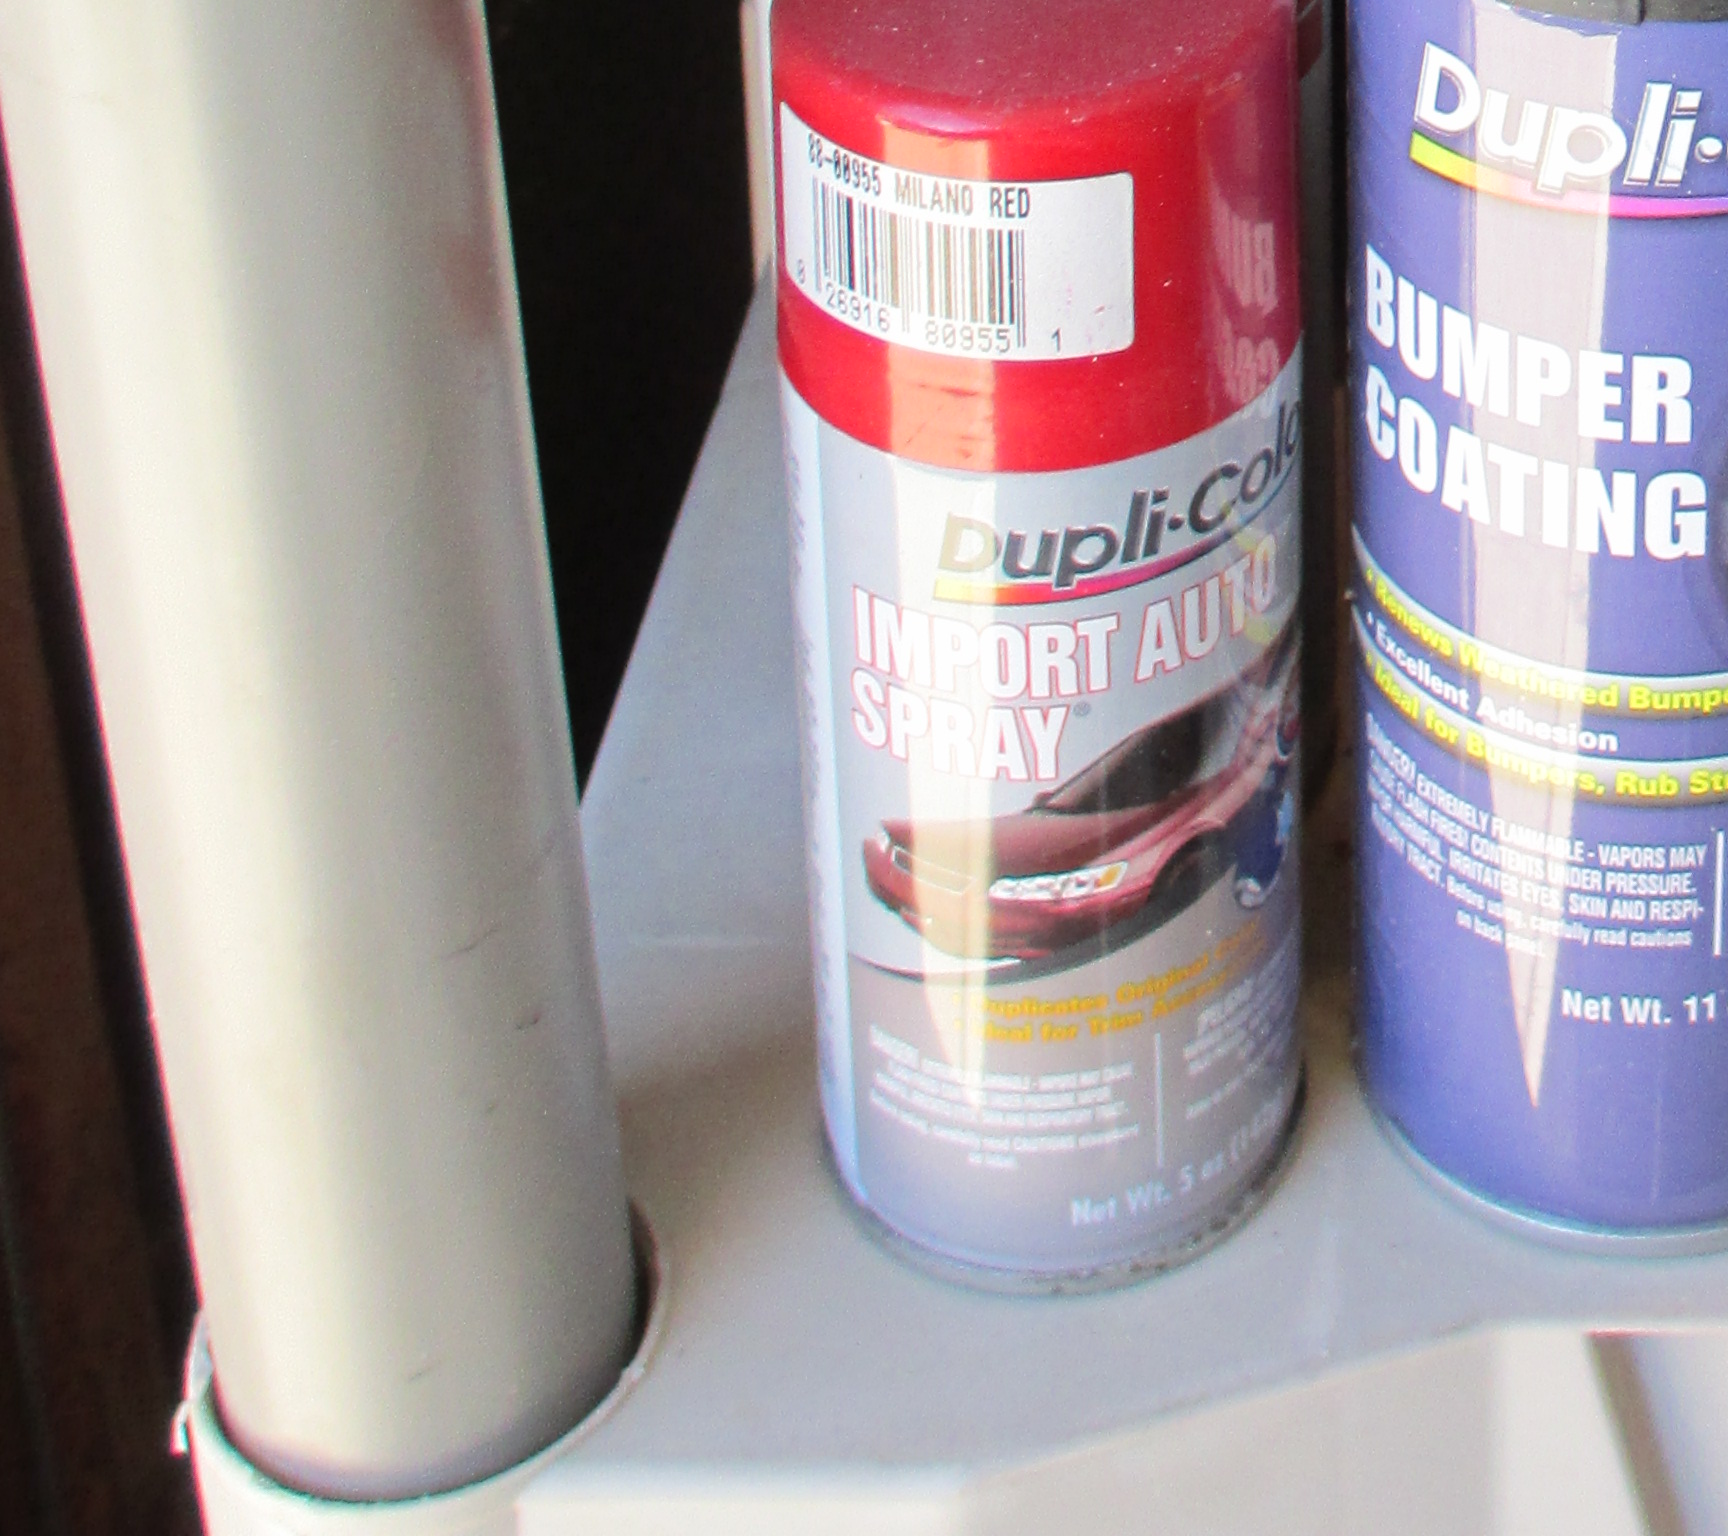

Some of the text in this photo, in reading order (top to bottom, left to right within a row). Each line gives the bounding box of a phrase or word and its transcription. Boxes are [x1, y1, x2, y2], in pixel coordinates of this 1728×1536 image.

[894, 178, 975, 218] MILANO
[989, 186, 1032, 220] RED
[826, 281, 891, 334] 26916
[924, 321, 1012, 355] 80955
[1050, 328, 1063, 354] 1
[1365, 243, 1694, 446] BUMPER
[936, 400, 1300, 590] Dupli-Colo
[1365, 364, 1709, 561] COATING
[852, 532, 1278, 702] IMPORT AUTO
[1375, 577, 1454, 658] Renews
[1458, 639, 1620, 710] Weathered
[850, 666, 1070, 783] SPRAY
[1376, 623, 1620, 754] Excellent Adhesion
[1424, 705, 1459, 746] for
[1615, 770, 1680, 798] Rub
[1416, 769, 1490, 833] EXTREMELY
[1489, 813, 1585, 864] FLAMMABLE
[1598, 843, 1666, 869] VAPORS
[1668, 843, 1708, 868] MAY
[1469, 833, 1545, 880] CONTENTS
[1547, 860, 1601, 893] UNDER
[1605, 871, 1698, 897] PRESSURE.
[1448, 847, 1520, 899] IRRITATES
[1568, 892, 1608, 919] SKIN
[1609, 896, 1646, 921] AND
[1648, 897, 1705, 921] RESPI-
[1593, 928, 1627, 948] read
[1560, 987, 1612, 1023] Net
[1621, 993, 1672, 1026] Wt.
[1683, 991, 1718, 1022] 11
